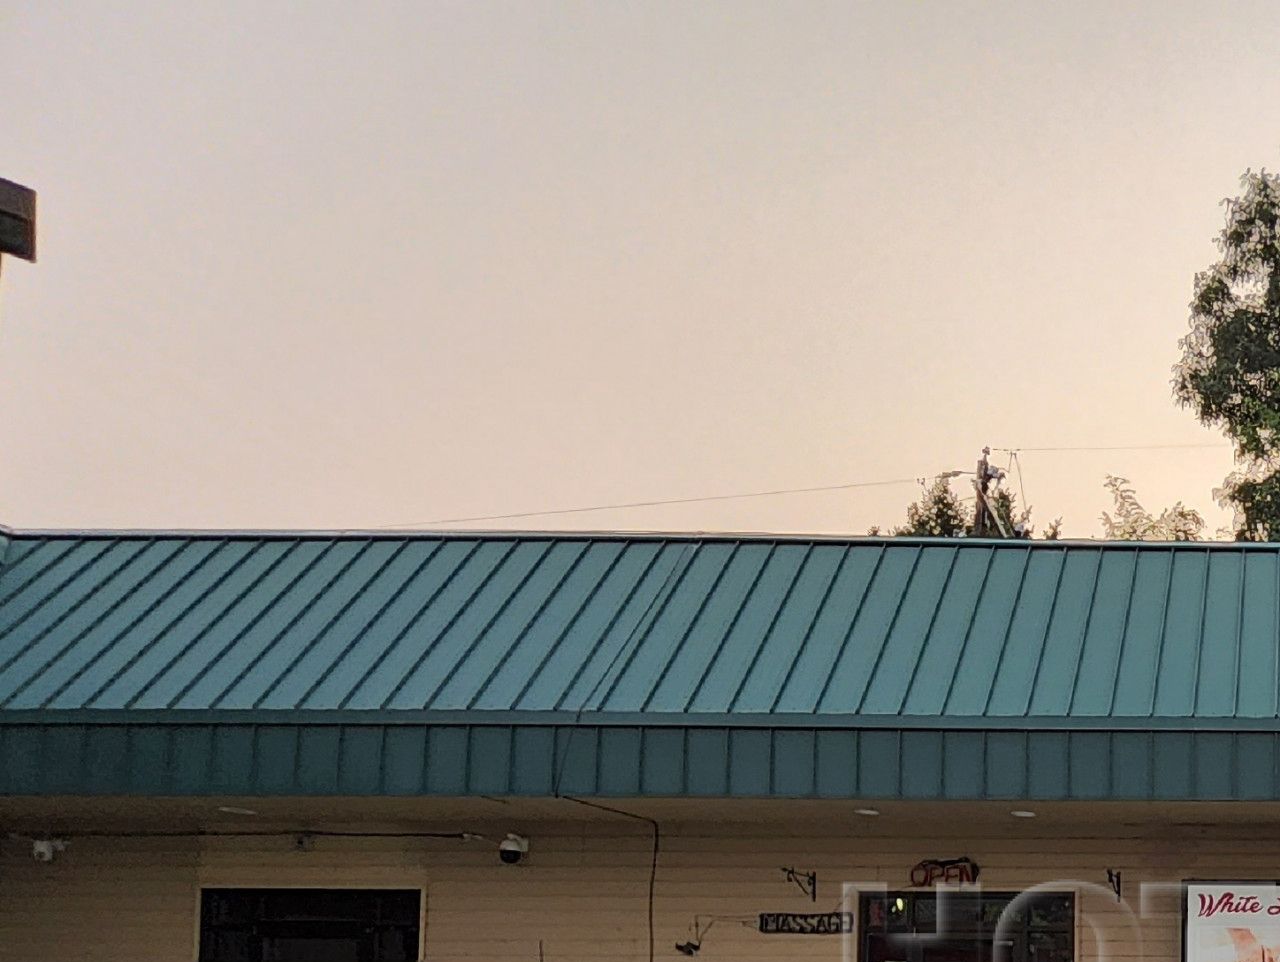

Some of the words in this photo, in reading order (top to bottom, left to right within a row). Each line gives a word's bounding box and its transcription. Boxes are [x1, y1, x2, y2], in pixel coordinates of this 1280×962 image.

[911, 864, 979, 888] OPEN
[1198, 892, 1263, 918] White
[760, 913, 853, 934] MASSAGE
